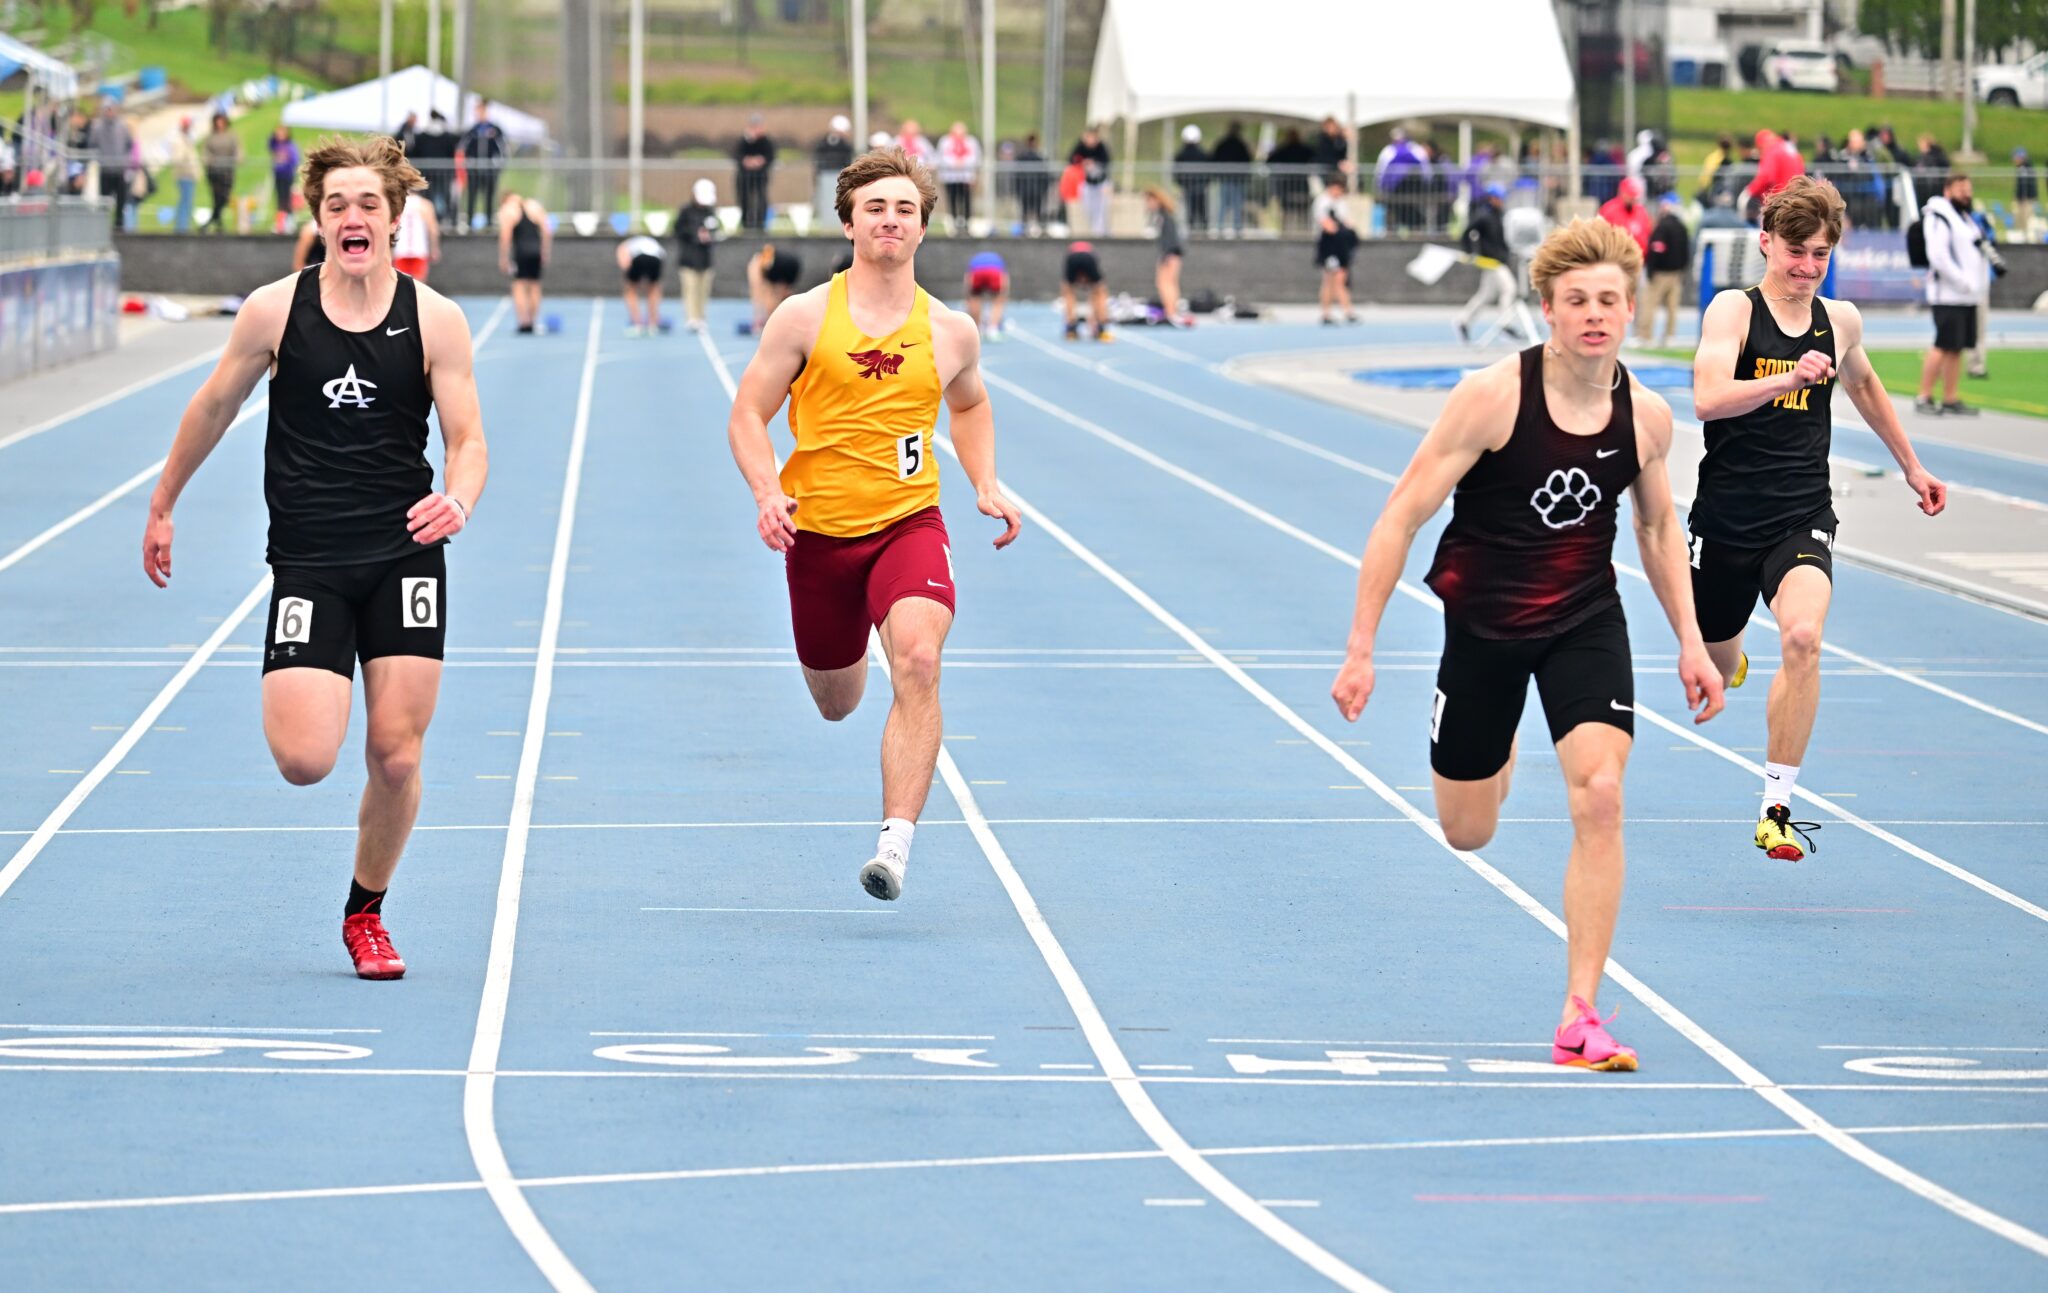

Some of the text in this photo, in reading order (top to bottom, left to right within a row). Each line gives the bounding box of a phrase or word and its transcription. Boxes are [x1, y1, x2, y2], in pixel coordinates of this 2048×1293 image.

[905, 435, 919, 475] 5
[282, 600, 304, 639] 6
[410, 581, 431, 624] 6
